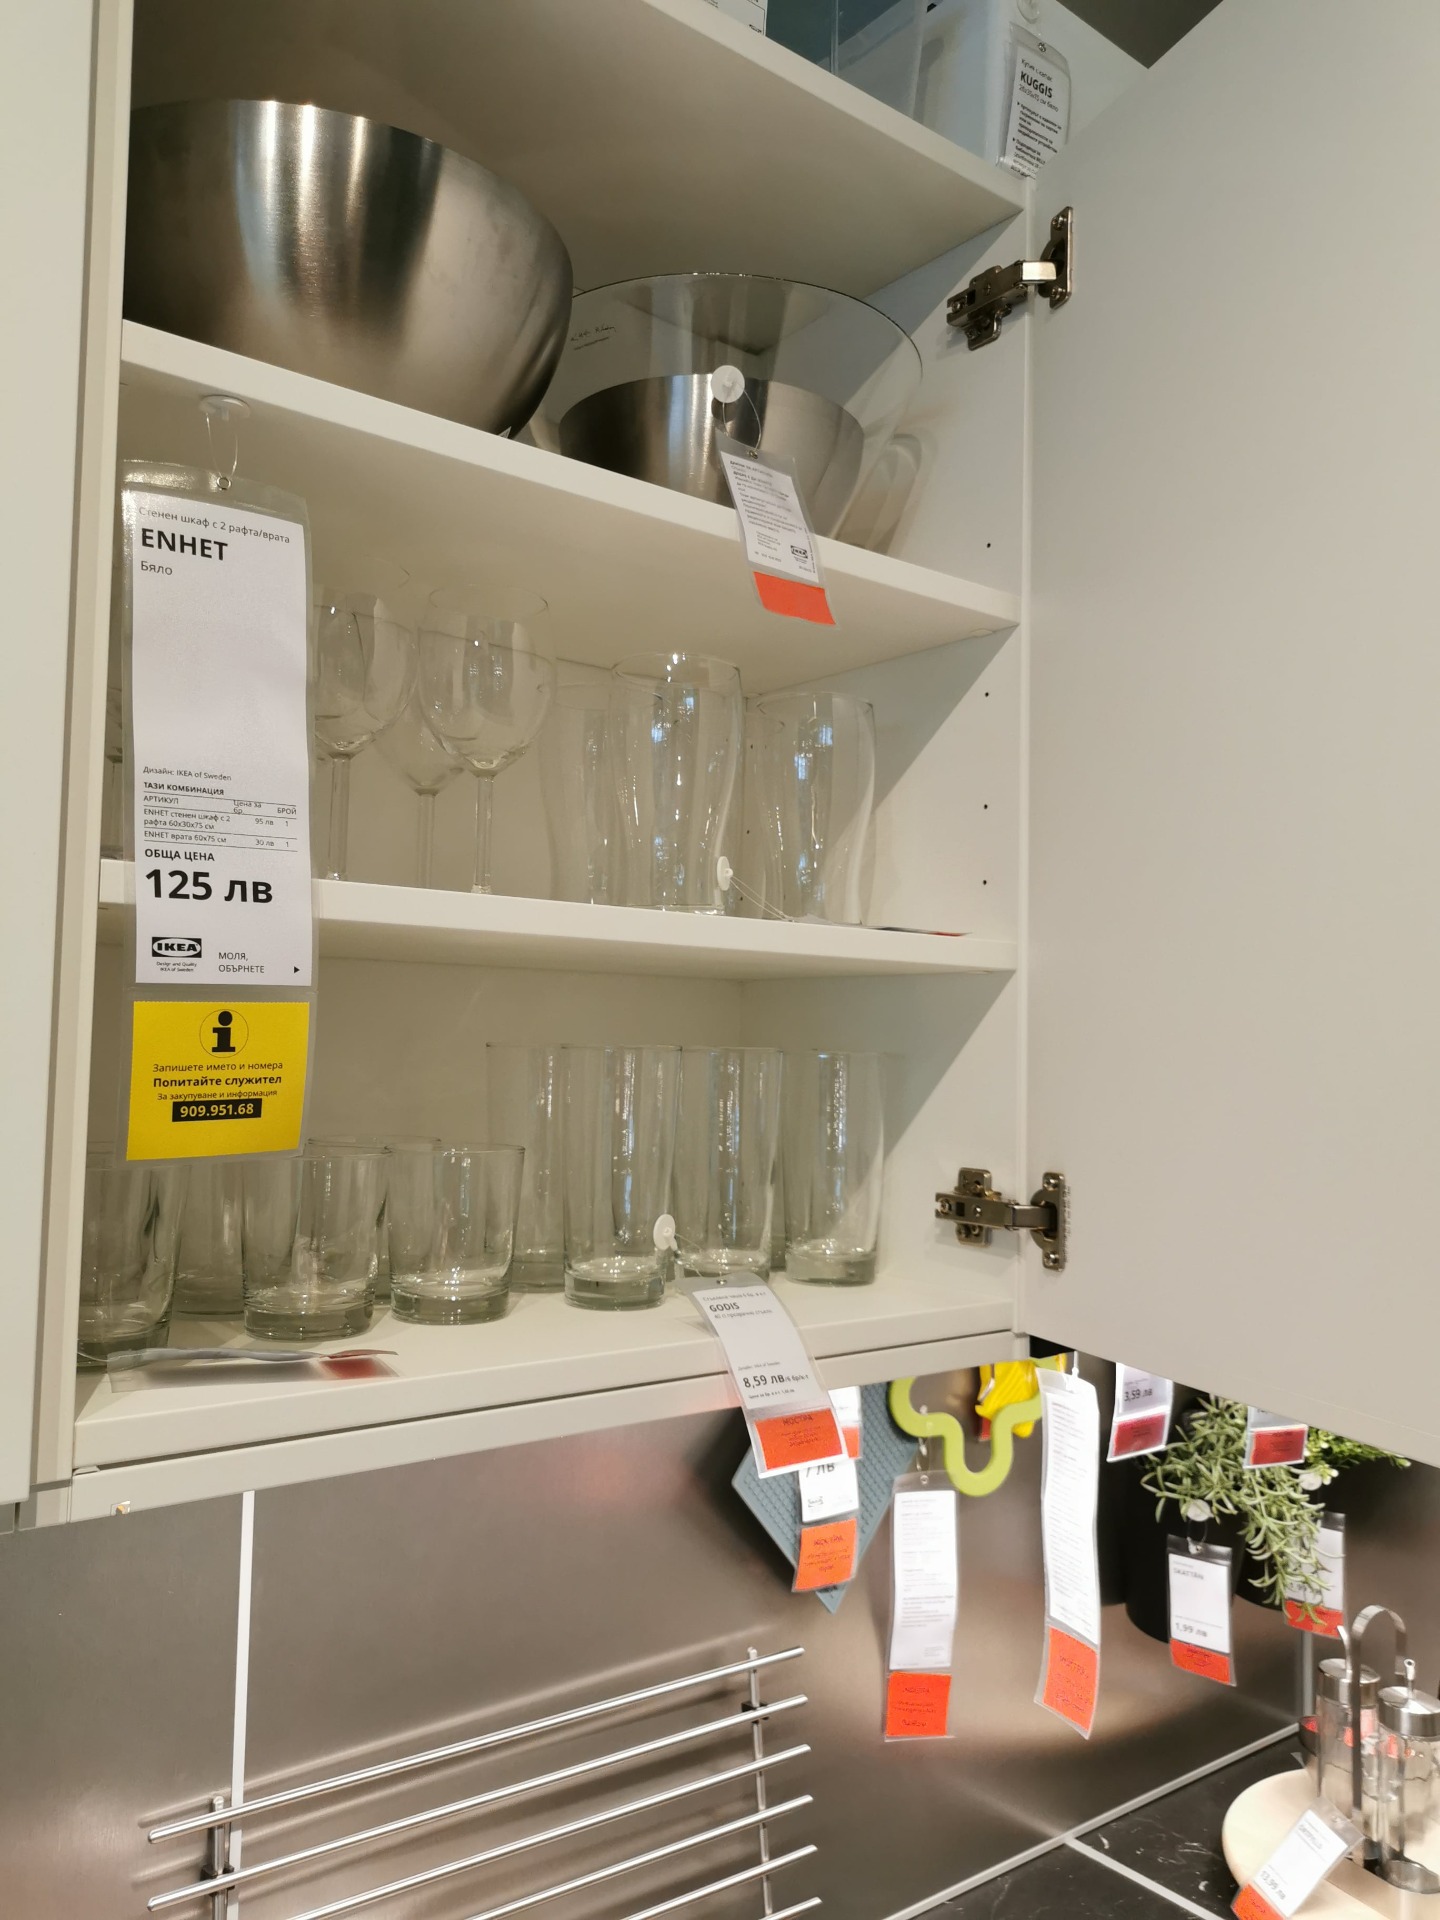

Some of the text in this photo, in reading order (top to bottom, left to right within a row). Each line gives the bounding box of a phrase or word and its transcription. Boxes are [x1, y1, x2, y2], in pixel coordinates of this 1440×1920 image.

[1020, 70, 1053, 99] KUGGIS
[138, 507, 290, 544] Стенен шкаф с 2 рафта/врата
[141, 528, 228, 561] ENHET
[140, 560, 173, 576] Бяло
[143, 766, 232, 781] Дизайн: IKEA of Sweden
[143, 782, 225, 796] ТАЗИ КОМБИНАЦИЯ
[143, 796, 179, 804] АРТИКУЛ
[144, 808, 168, 817] ENHET
[170, 812, 197, 820] стенен
[199, 813, 218, 822] шкаф
[277, 806, 297, 815] БРОЙ
[144, 819, 167, 828] рафта
[254, 817, 263, 825] 95
[144, 830, 168, 839] ENHET
[170, 833, 193, 842] врата
[255, 838, 264, 846] 30
[144, 848, 215, 862] ОБЩА ЦЕНА
[145, 869, 213, 901] 125
[218, 952, 248, 961] МОЛЯ,
[218, 964, 265, 973] ОБЪРНЕТЕ
[152, 1063, 204, 1073] Запишете
[206, 1063, 236, 1072] името
[247, 1062, 283, 1071] номера
[153, 1075, 282, 1089] Попитайте служител
[169, 1092, 217, 1102] закупуване
[226, 1090, 277, 1099] информация
[180, 1103, 254, 1118] 909.951.68
[709, 1302, 740, 1312] GODIS
[742, 1374, 768, 1388] 8,59
